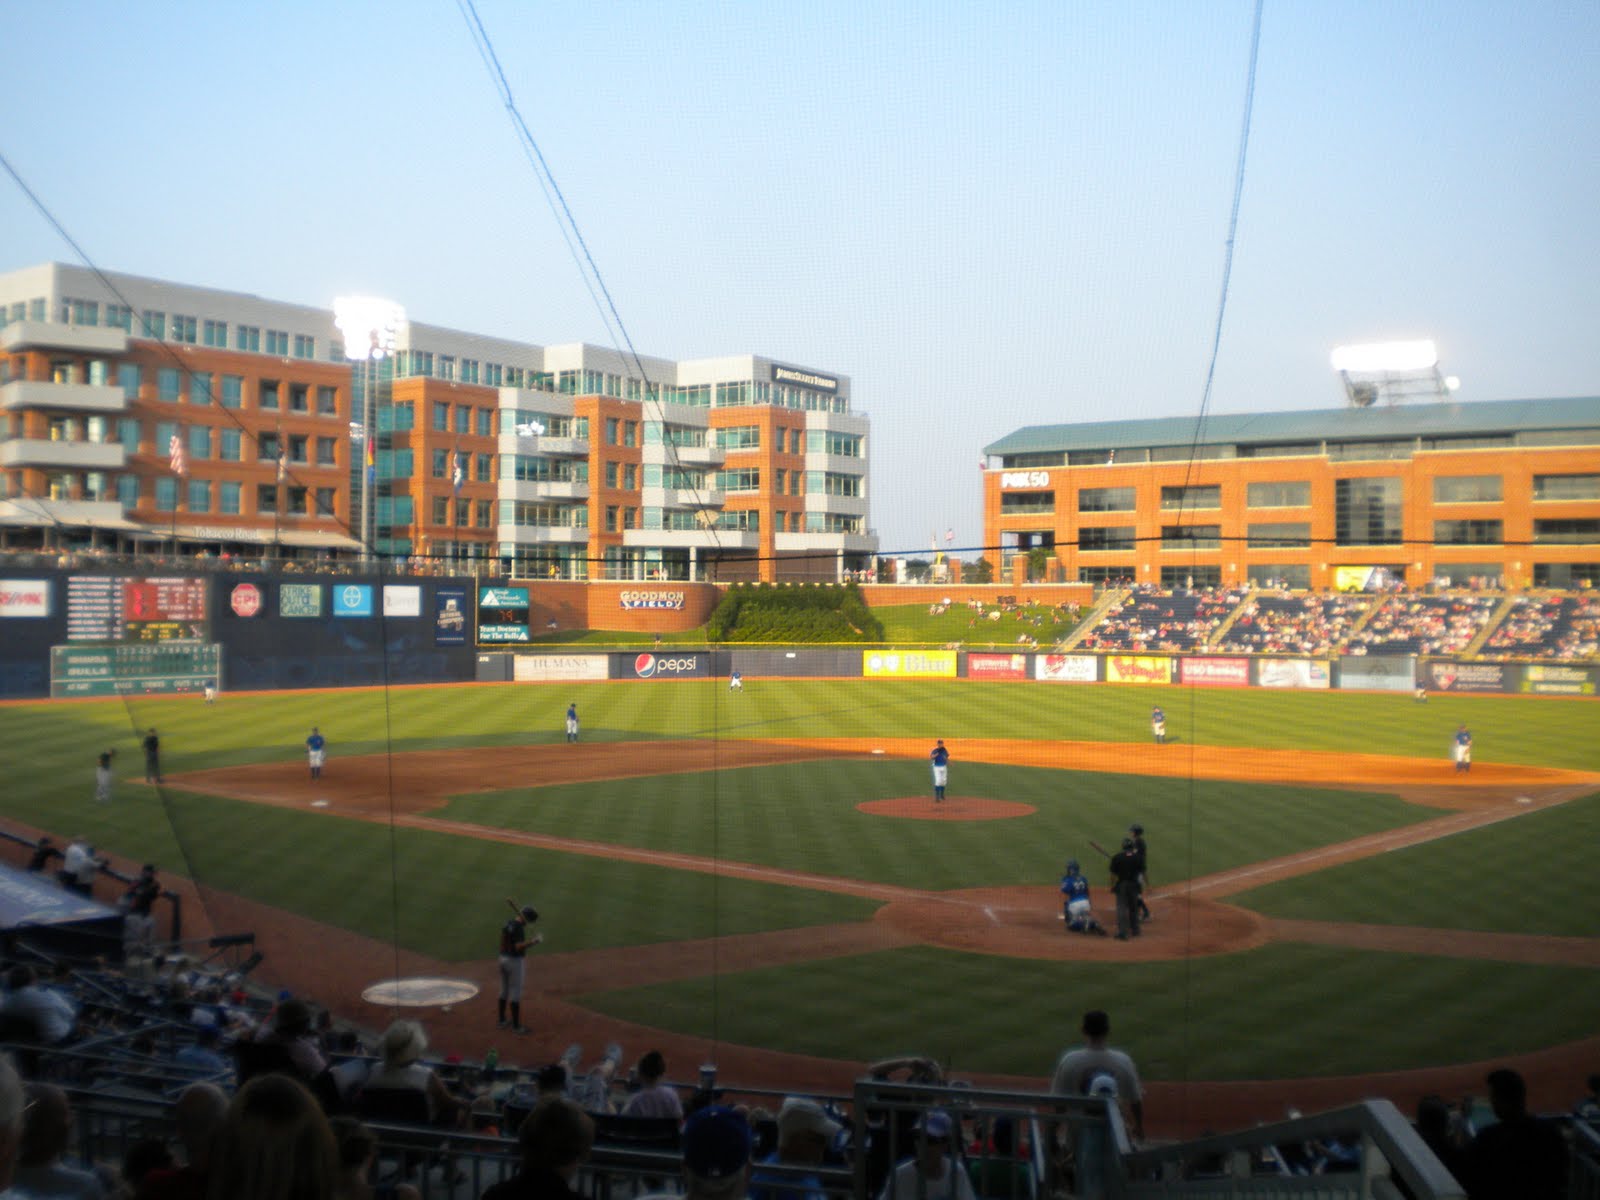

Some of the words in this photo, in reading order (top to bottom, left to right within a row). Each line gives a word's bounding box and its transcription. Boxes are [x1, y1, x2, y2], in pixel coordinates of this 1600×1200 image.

[620, 591, 684, 600] GOODMON
[633, 600, 674, 608] FIELD
[532, 658, 589, 668] HUMANA
[656, 656, 697, 673] pepsi
